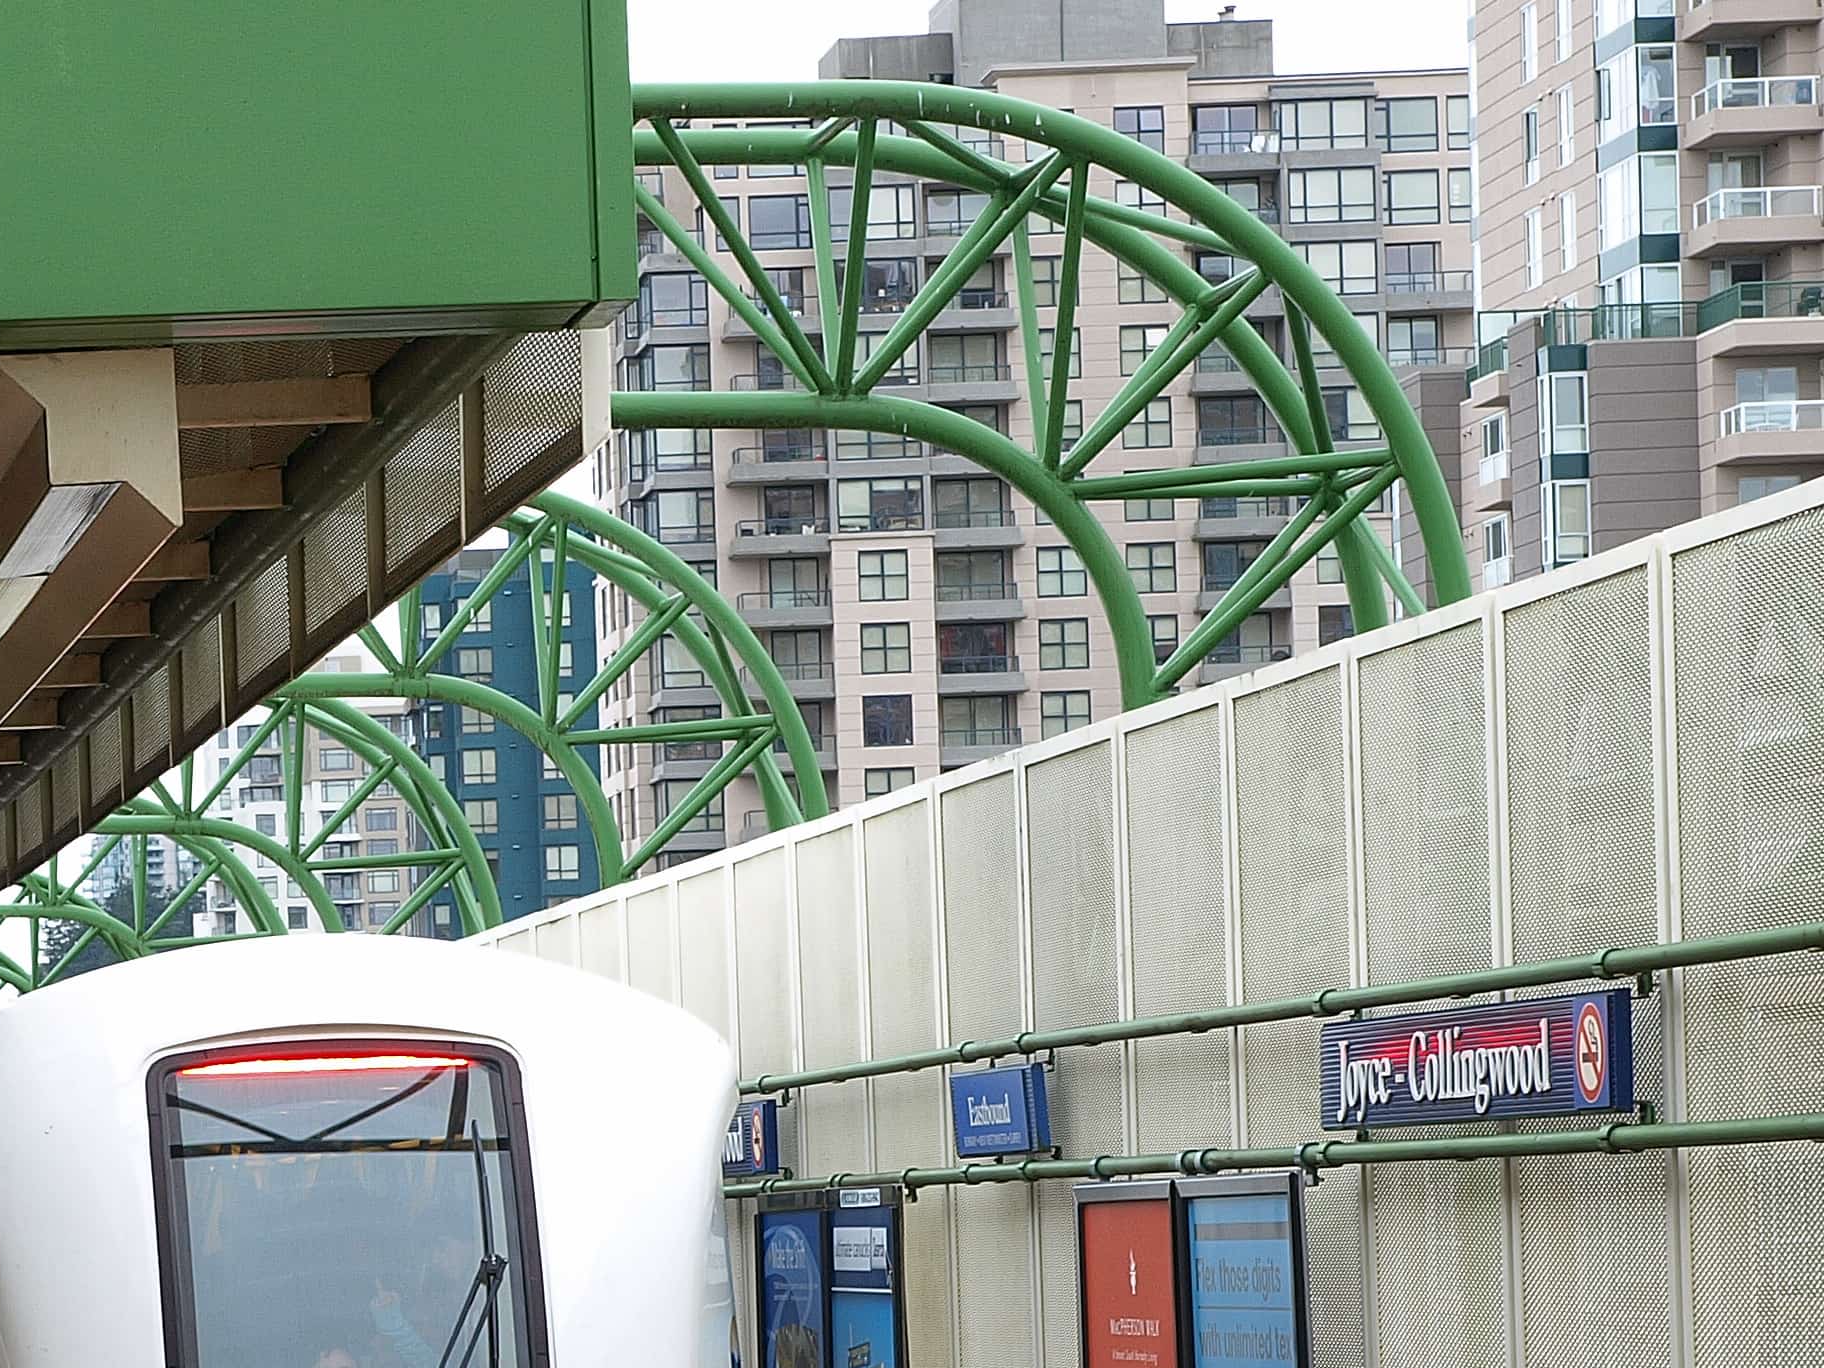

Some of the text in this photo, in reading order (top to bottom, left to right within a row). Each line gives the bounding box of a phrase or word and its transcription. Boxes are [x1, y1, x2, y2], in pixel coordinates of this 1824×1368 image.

[1196, 1257, 1281, 1301] Flex those digits
[1199, 1323, 1221, 1358] with
[1224, 1323, 1272, 1360] unlimited
